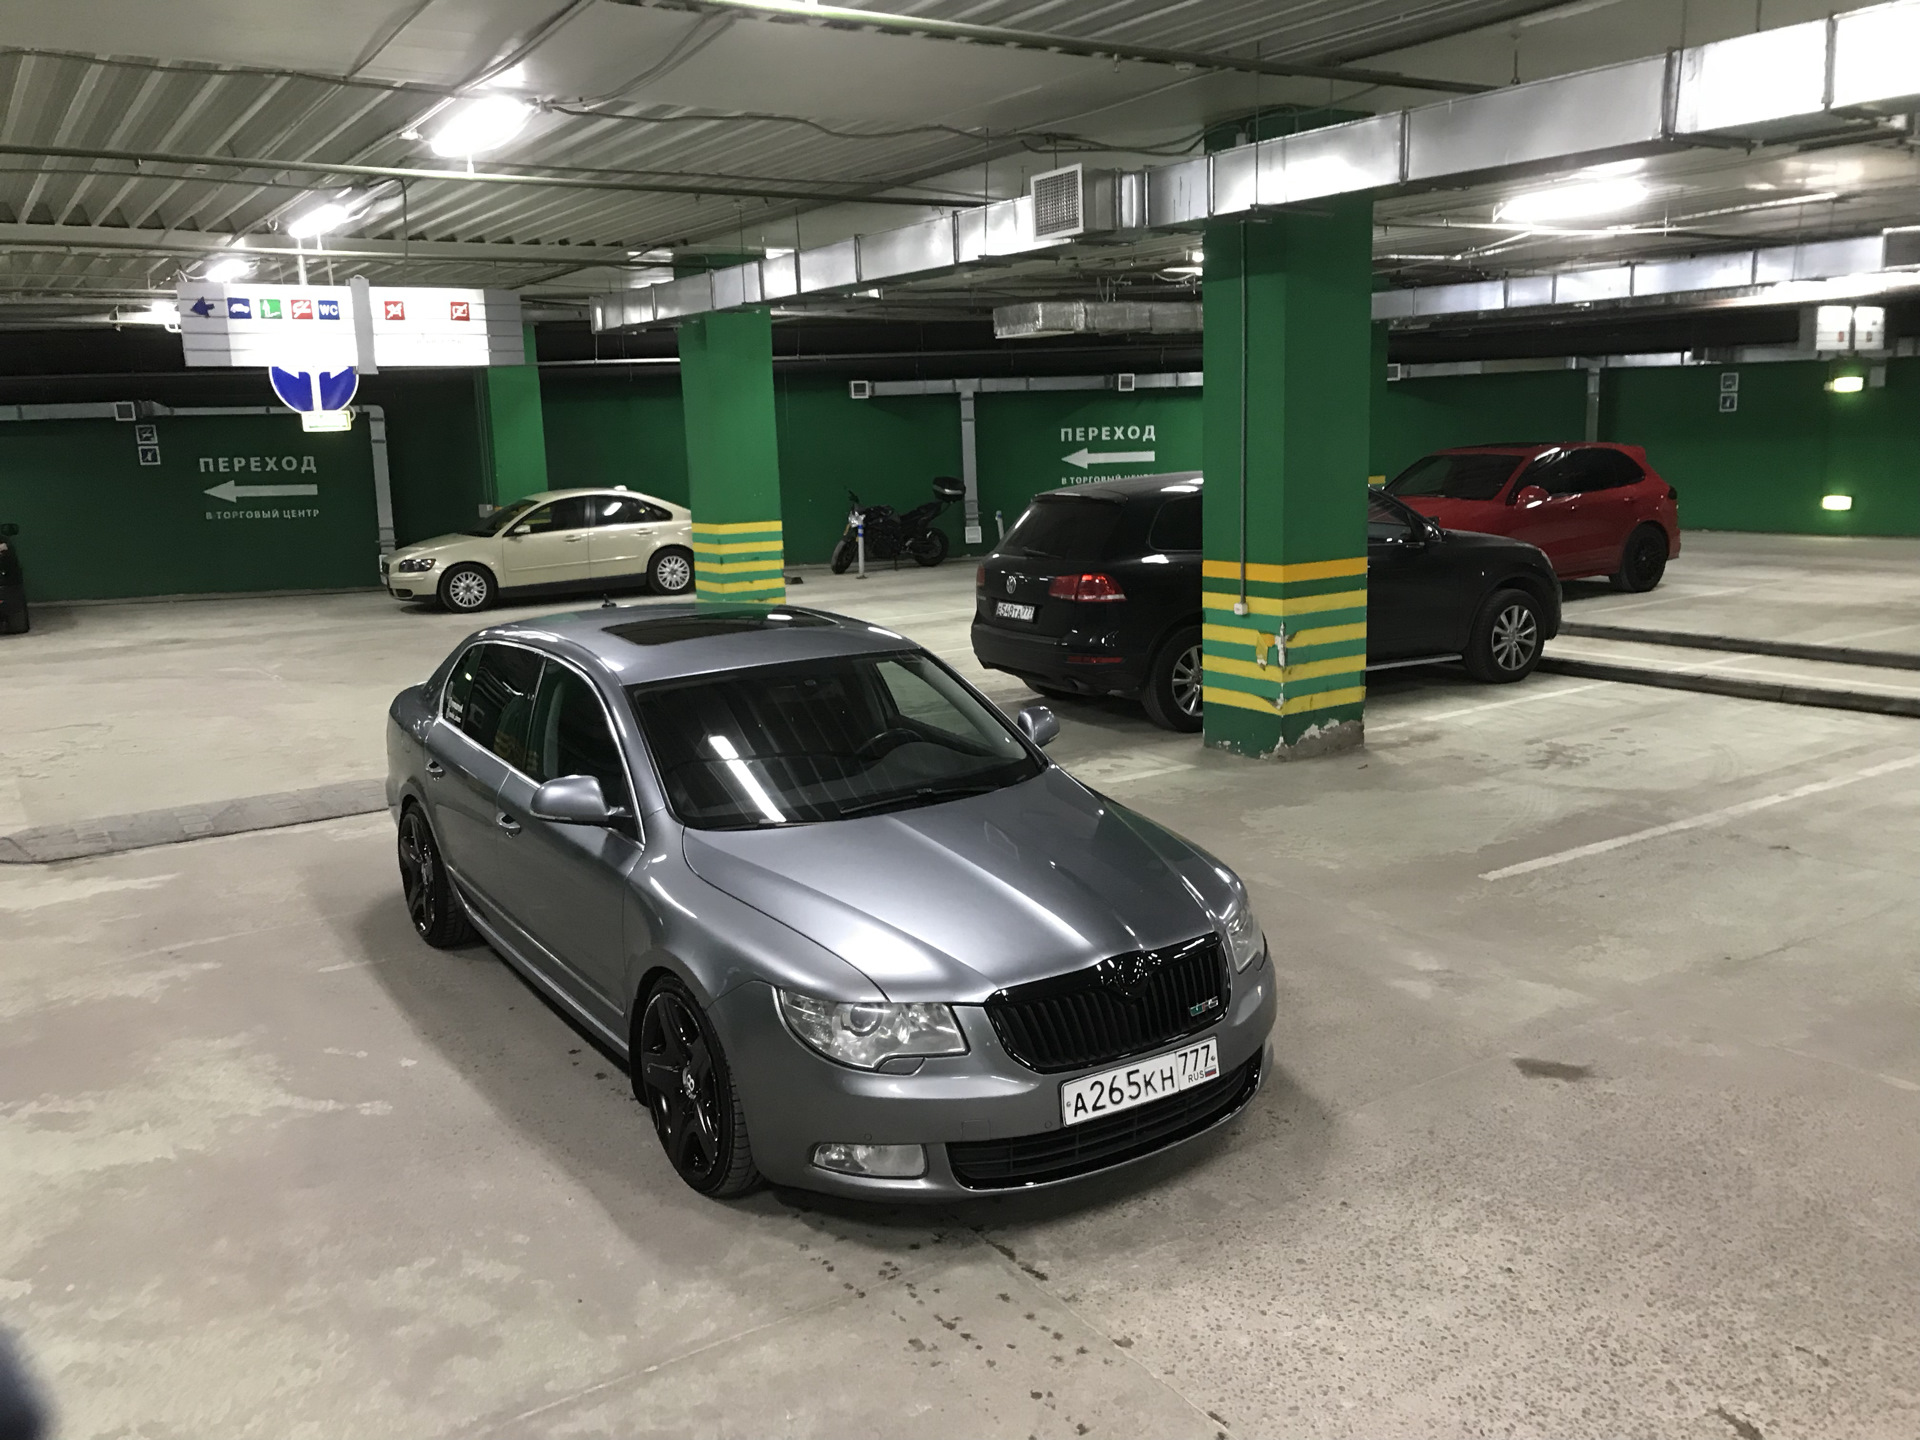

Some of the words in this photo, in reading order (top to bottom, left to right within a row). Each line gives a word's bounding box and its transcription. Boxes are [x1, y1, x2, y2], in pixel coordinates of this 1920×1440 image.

[319, 304, 338, 316] WC
[1060, 425, 1156, 442] ПЕРЕХОД
[199, 456, 317, 474] ПЕРЕХОД
[1061, 477, 1067, 485] В
[205, 511, 213, 520] В
[216, 509, 280, 520] ТОРГОВЫЙ
[283, 509, 320, 520] ЦЕНТР
[1178, 1044, 1211, 1076] 777
[1187, 1069, 1205, 1083] RUS
